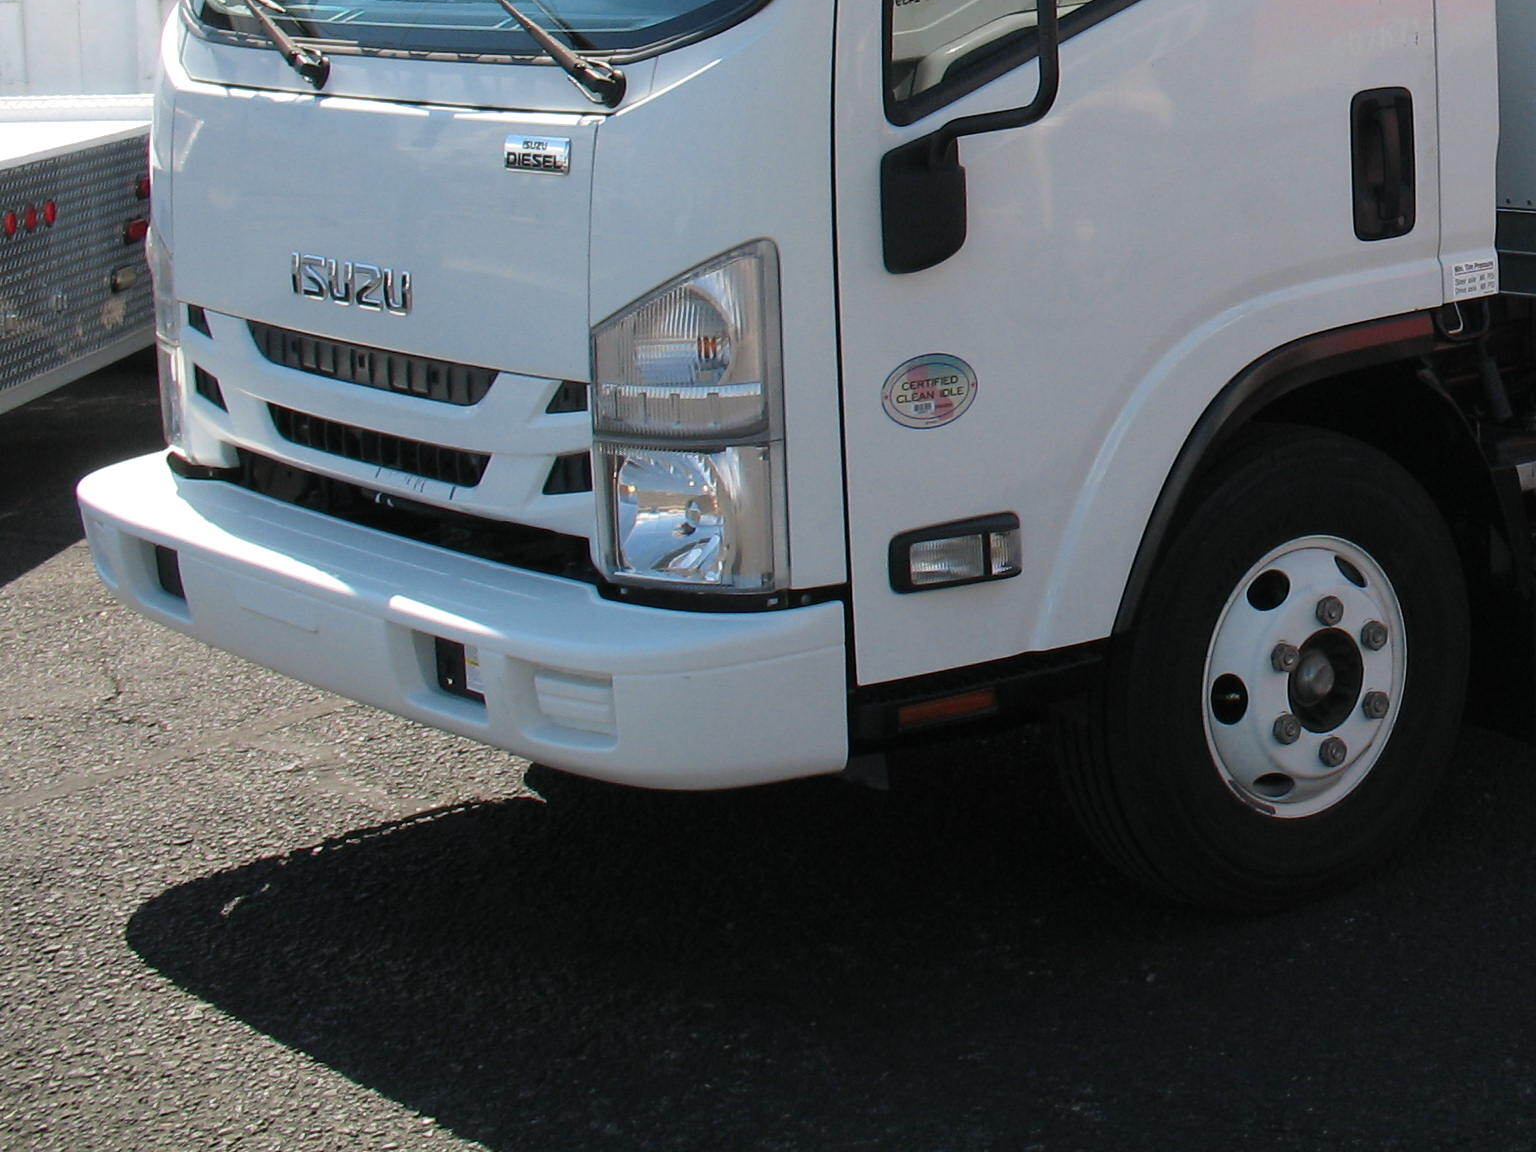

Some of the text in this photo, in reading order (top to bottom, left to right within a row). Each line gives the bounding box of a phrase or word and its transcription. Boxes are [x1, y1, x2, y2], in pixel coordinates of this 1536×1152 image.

[506, 152, 562, 169] DIESEL
[290, 251, 413, 317] ISUZU
[901, 374, 959, 391] CERTIFIED
[896, 386, 965, 404] CLEAN IDLE
